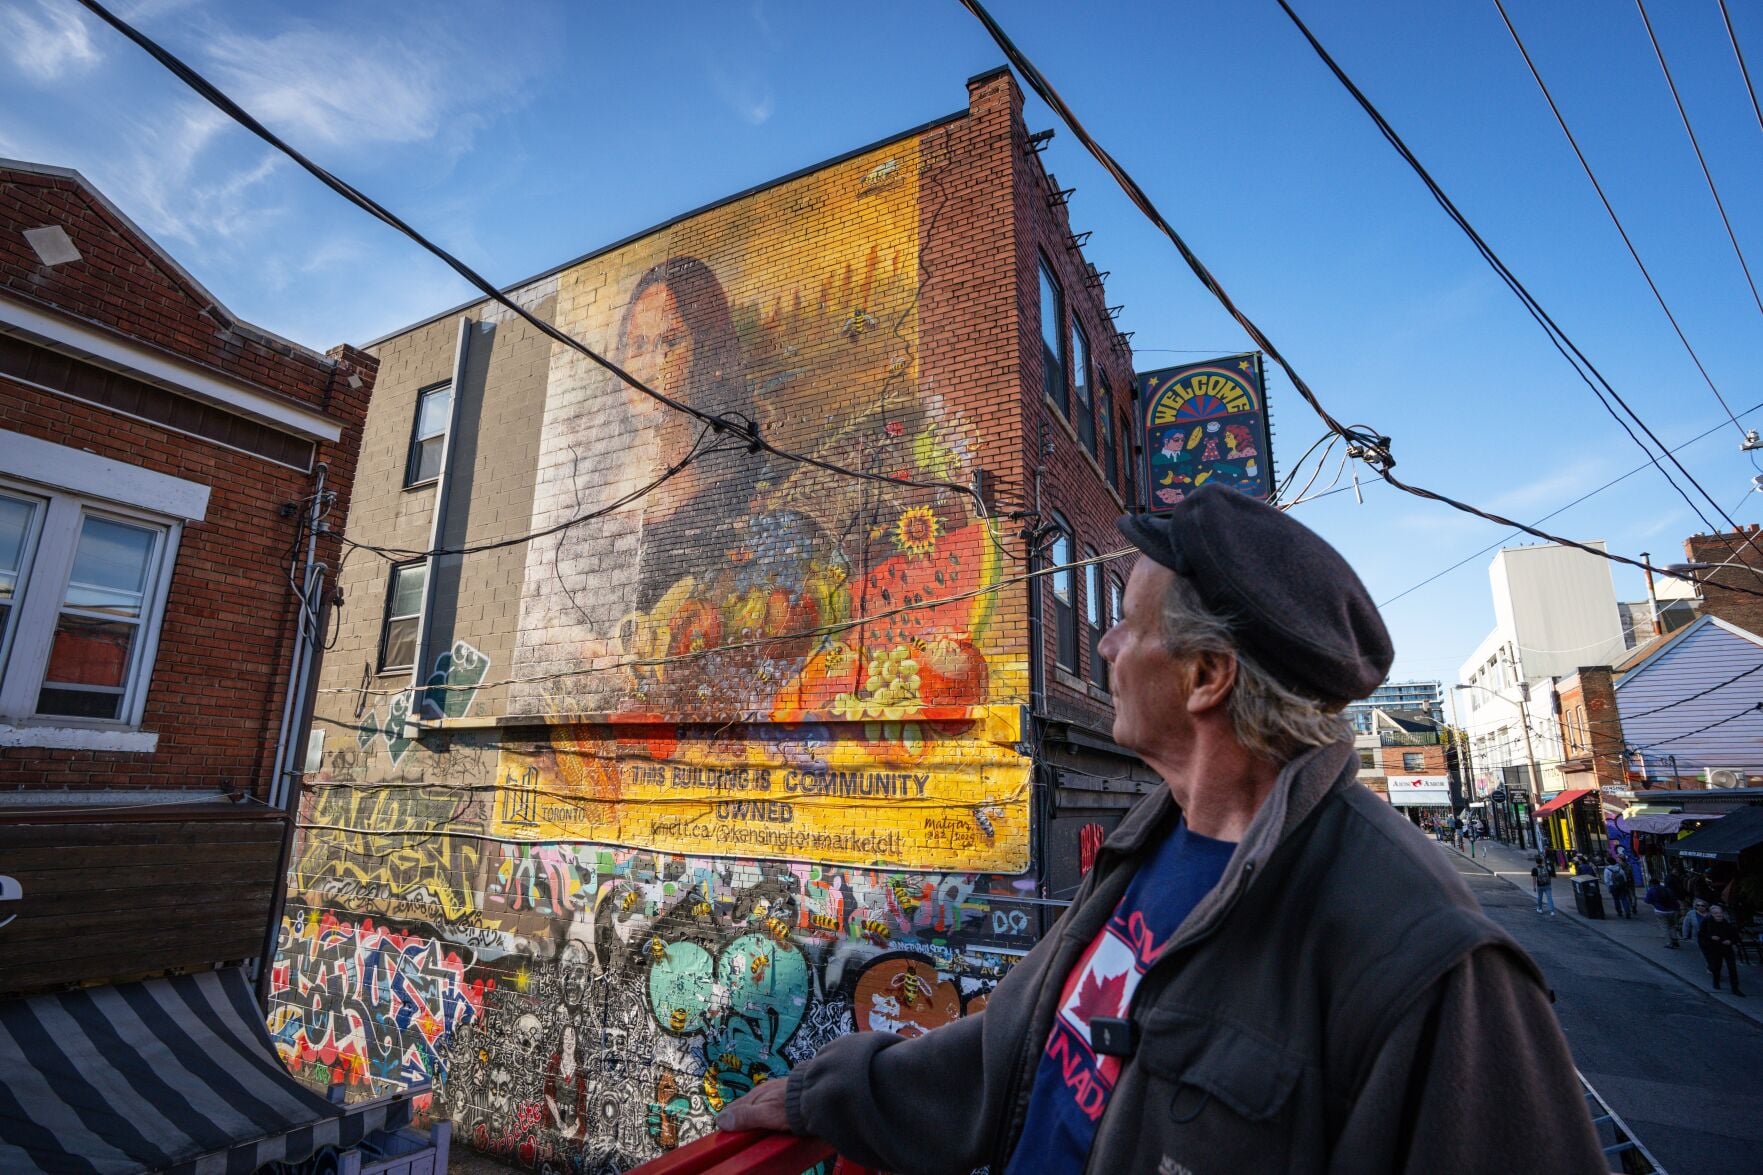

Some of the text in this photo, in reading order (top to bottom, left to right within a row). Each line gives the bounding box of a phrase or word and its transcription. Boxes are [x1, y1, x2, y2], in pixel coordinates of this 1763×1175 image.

[1154, 375, 1250, 425] WELCOME
[632, 765, 929, 798] THIS BUILDING IS COMMUNITY
[716, 800, 793, 823] OWNED
[1045, 1023, 1107, 1121] NAD
